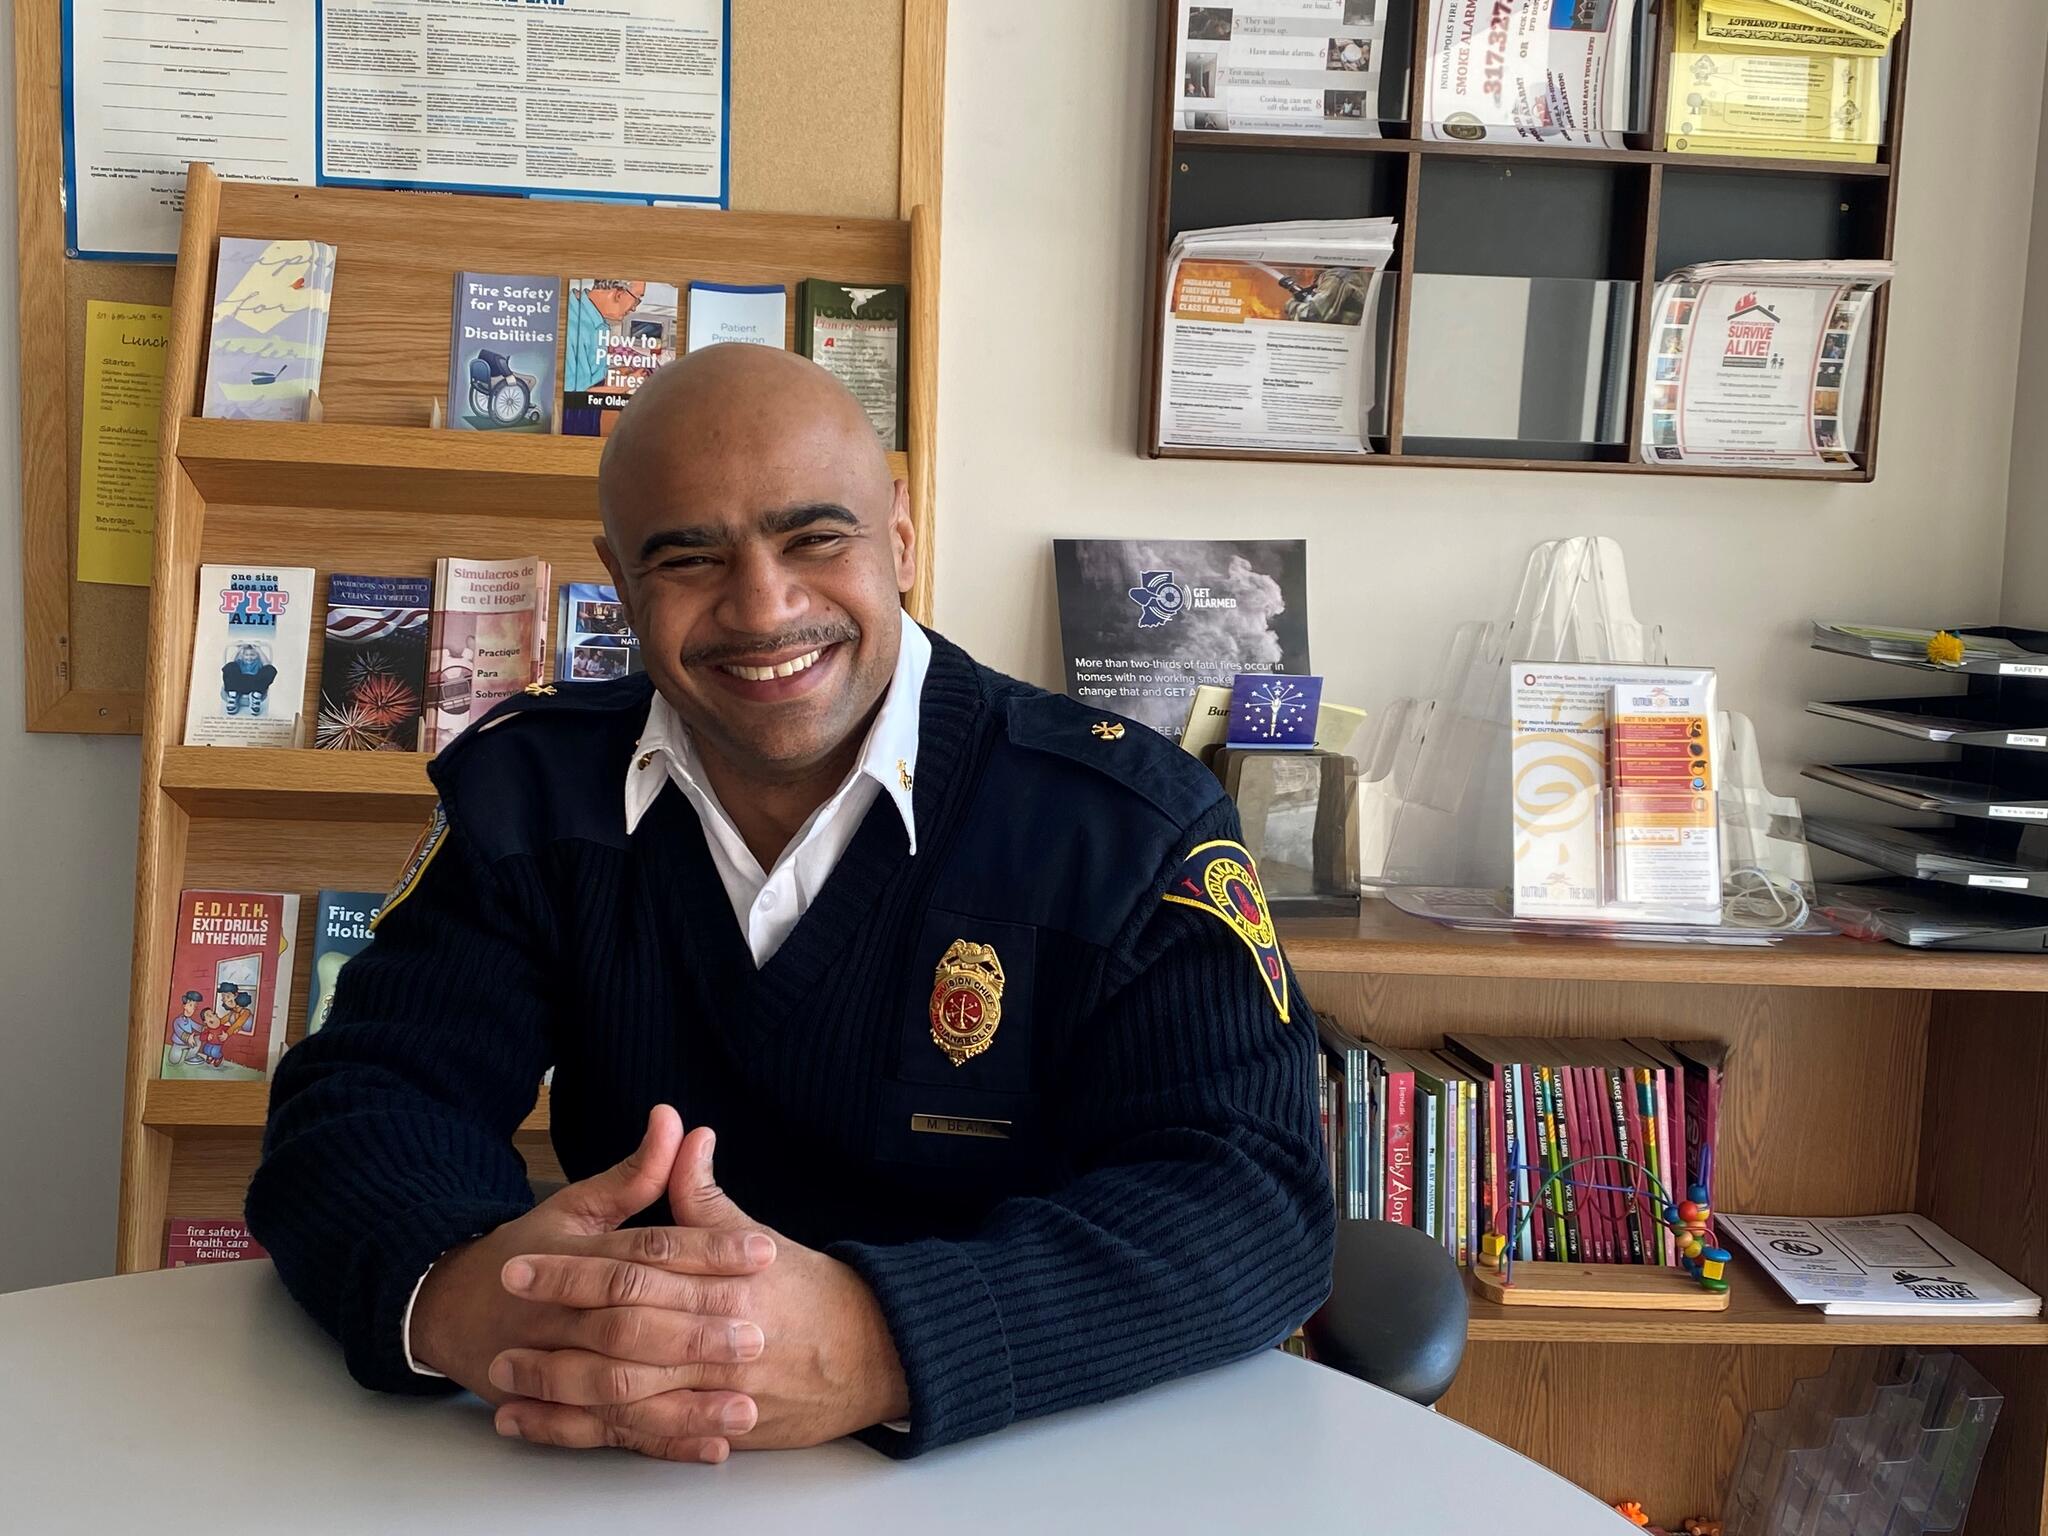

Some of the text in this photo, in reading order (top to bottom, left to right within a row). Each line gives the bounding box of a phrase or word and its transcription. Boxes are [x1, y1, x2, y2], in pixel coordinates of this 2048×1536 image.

[1233, 18, 1240, 29] 5
[1245, 16, 1276, 26] They will
[1727, 18, 1814, 32] SAFETY CONTRACT
[1263, 27, 1275, 35] you
[1276, 27, 1288, 35] up.
[1249, 48, 1268, 56] Have
[1319, 48, 1326, 58] 6
[1440, 2, 1458, 90] INDIANAPOLIS FIRE
[1519, 41, 1529, 58] OR
[1228, 68, 1264, 77] Test smoke
[1455, 47, 1470, 96] SMOKE
[1585, 57, 1593, 78] YOUR
[1218, 70, 1225, 80] 7
[1251, 77, 1267, 85] each
[1259, 95, 1288, 105] Cooking
[1315, 99, 1322, 109] 8
[1266, 103, 1277, 112] off
[1279, 104, 1290, 112] the
[1183, 278, 1232, 289] INDIANAPOLIS
[468, 283, 554, 301] Fire Safety
[1181, 286, 1231, 297] FIREFIGHTERS
[470, 298, 551, 316] for People
[1178, 302, 1242, 315] CLASS EDUCATION
[492, 315, 528, 328] with
[720, 322, 757, 333] Patient
[464, 326, 554, 342] Disabilities
[598, 330, 657, 349] How to
[711, 333, 765, 343] Protection
[1727, 325, 1774, 340] SURVIVE
[122, 333, 169, 348] Lunch
[1724, 339, 1771, 357] ALIVE!
[102, 358, 136, 367] Starters
[595, 349, 658, 369] Prevent
[607, 369, 645, 388] Fires
[587, 394, 604, 406] For
[231, 573, 279, 582] one size
[454, 566, 534, 579] Simulacros de
[230, 582, 279, 592] does not
[469, 582, 520, 592] Incendio
[1193, 587, 1211, 598] GET
[219, 589, 289, 615] FIT
[460, 593, 526, 606] en el Hogar
[1194, 597, 1237, 609] ALARMED
[229, 613, 276, 626] ALL!
[478, 647, 521, 659] Practique
[1075, 657, 1284, 671] More than two-thirds of fatal fires occur in
[2013, 666, 2044, 674] SAFETY
[476, 669, 498, 678] Para
[1076, 672, 1233, 686] homes with no working smoke
[1078, 686, 1186, 699] change that and GET
[1521, 886, 1597, 900] OUTRUN THE SUN
[193, 901, 269, 918] E.D.I.T.H.
[328, 906, 364, 923] Fire
[192, 918, 269, 933] EXIT DRILLS
[191, 931, 267, 946] IN THE HOME
[935, 976, 996, 1009] DIVISION CHIEF
[933, 1013, 993, 1045] INDIANAPOLIS
[1504, 1069, 1513, 1094] LARGE
[1533, 1072, 1541, 1096] LARGE
[1553, 1074, 1562, 1097] LARGE
[1612, 1076, 1622, 1100] LARGE
[1505, 1094, 1513, 1115] PRINT
[1535, 1096, 1545, 1117] PRINT
[1556, 1099, 1565, 1119] PRINT
[1615, 1101, 1625, 1122] PRINT
[1560, 1138, 1569, 1158] SEARCH
[1388, 1142, 1412, 1225] Toby Alon
[187, 1225, 241, 1239] fire safety
[189, 1237, 248, 1248] health care
[196, 1248, 241, 1259] facilities
